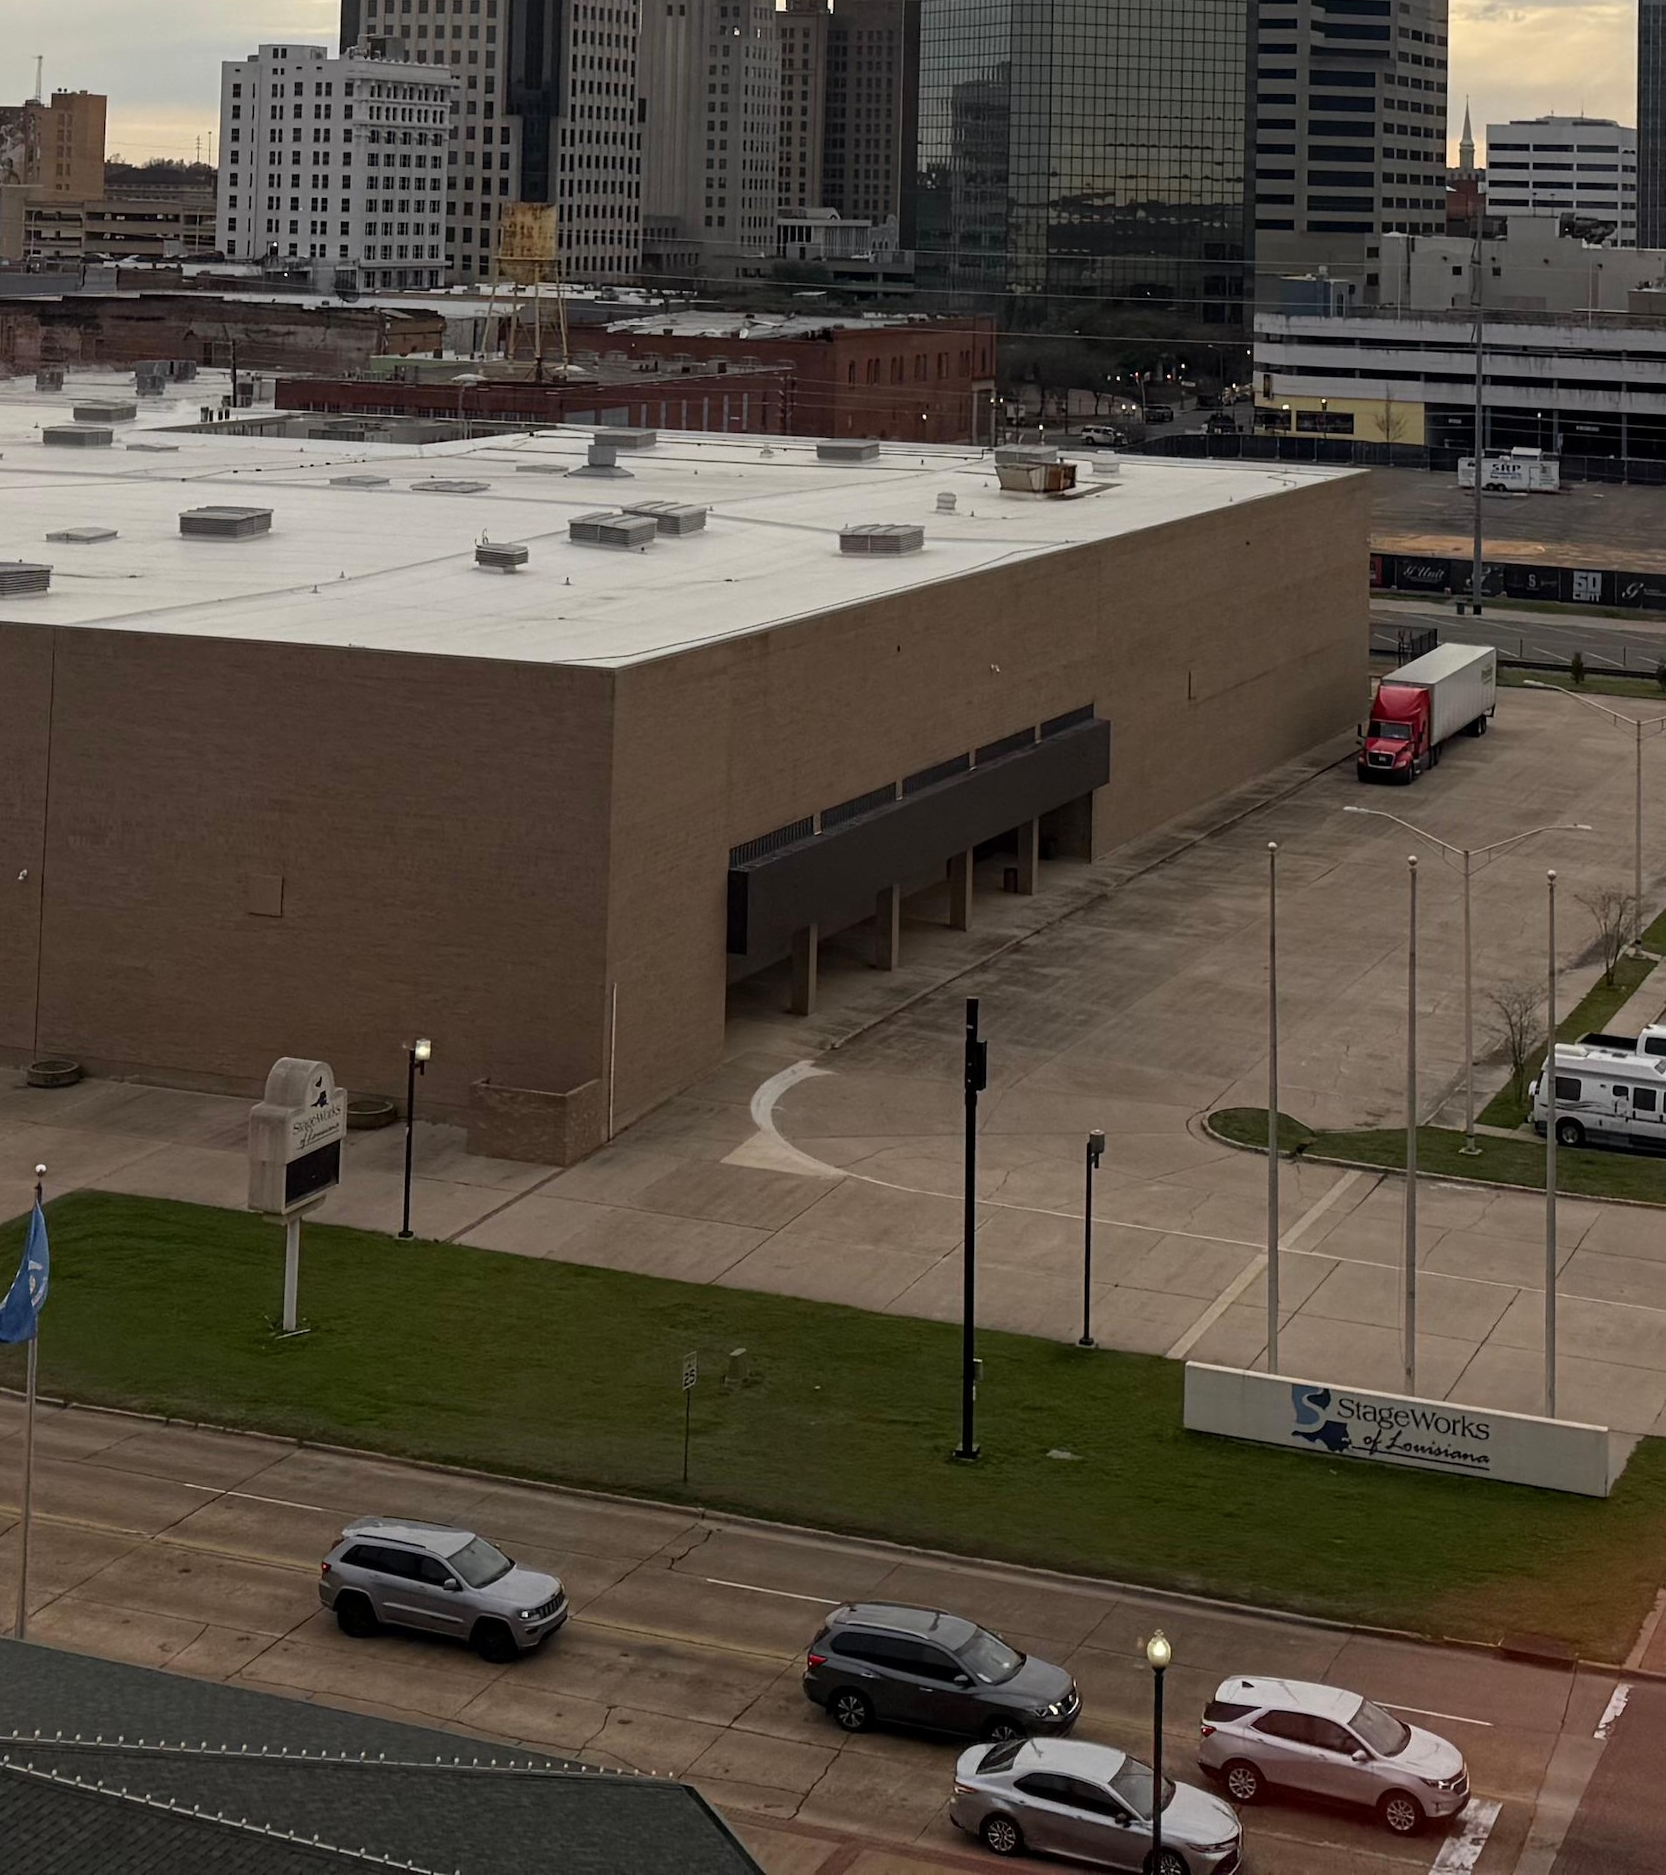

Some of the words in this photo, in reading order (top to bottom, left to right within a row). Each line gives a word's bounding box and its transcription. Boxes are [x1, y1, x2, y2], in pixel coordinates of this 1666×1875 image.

[1492, 463, 1521, 472] SRP
[1573, 571, 1601, 590] 50
[1337, 1398, 1490, 1441] StageWorks
[1364, 1429, 1382, 1456] of
[1386, 1430, 1490, 1465] Louisiana
